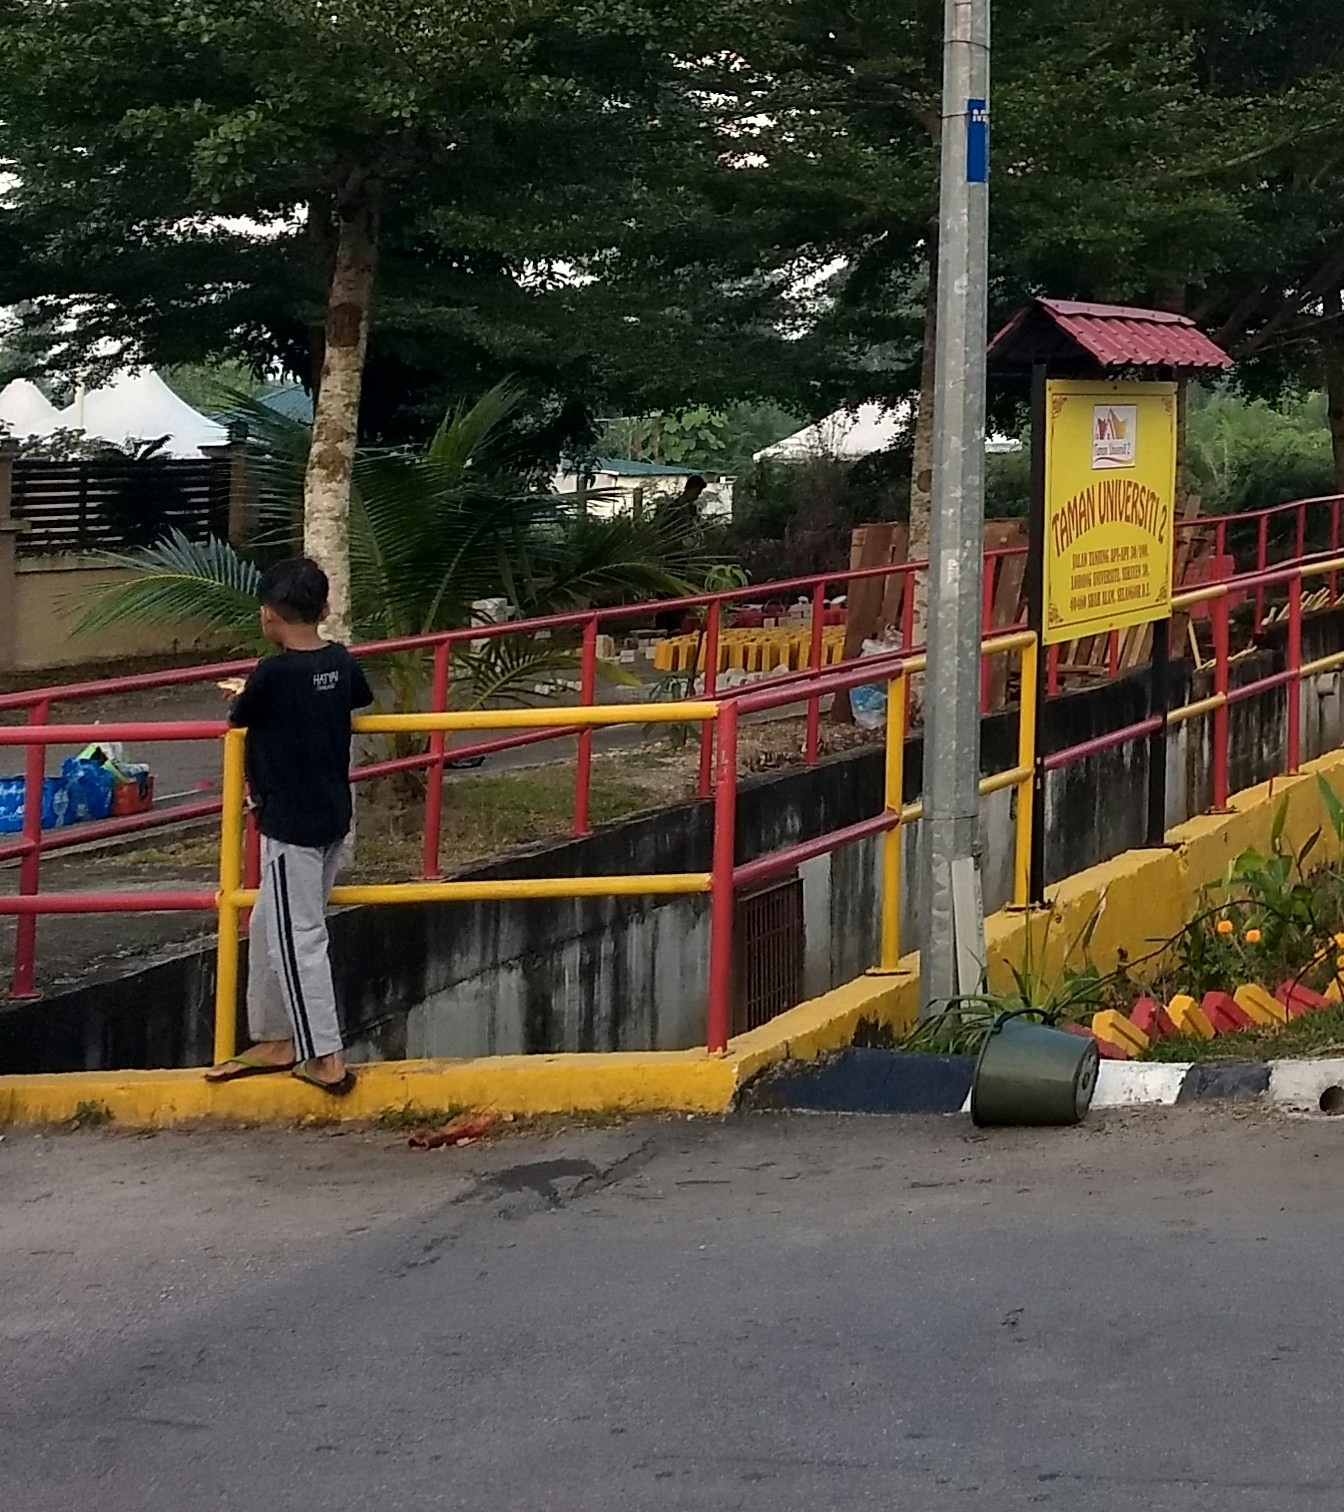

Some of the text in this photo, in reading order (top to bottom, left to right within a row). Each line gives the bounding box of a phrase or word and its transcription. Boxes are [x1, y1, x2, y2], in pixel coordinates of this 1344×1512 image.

[1052, 479, 1167, 558] TAMAN UNIVERSITI 2
